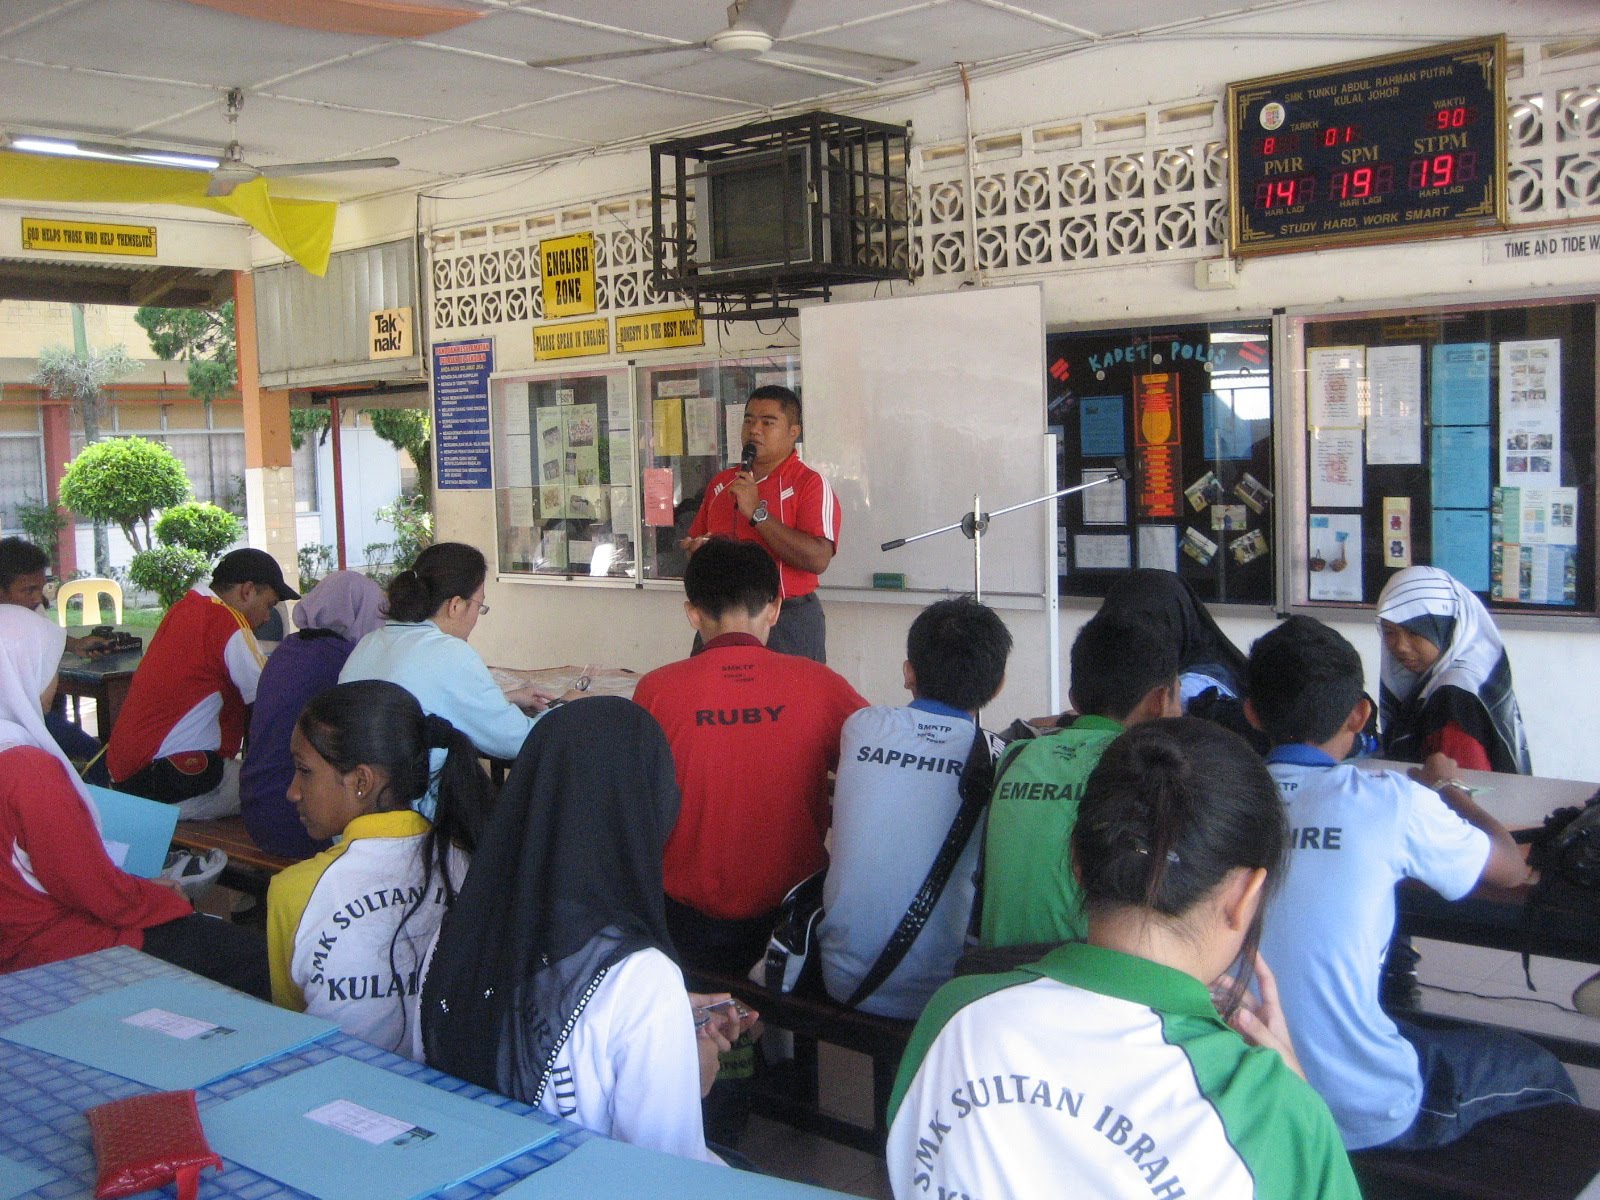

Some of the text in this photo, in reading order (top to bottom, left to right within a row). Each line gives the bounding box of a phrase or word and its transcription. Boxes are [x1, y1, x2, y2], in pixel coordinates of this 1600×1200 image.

[1308, 86, 1337, 99] TUNKU
[1341, 80, 1371, 94] ABDUL
[1376, 72, 1416, 87] RAHMAN
[1420, 65, 1453, 79] PUTRA
[1368, 87, 1399, 101] JOHOR
[1433, 97, 1465, 109] WAKTU
[1290, 120, 1319, 132] TARIKH
[1414, 131, 1468, 155] STPM
[1264, 157, 1304, 175] PMR
[1341, 145, 1379, 165] SPM
[1420, 154, 1453, 187] 19
[1265, 180, 1295, 209] 14
[1341, 168, 1372, 199] 19
[1419, 185, 1464, 198] HARI LAGI
[1265, 205, 1305, 216] HARI LAGI
[1363, 196, 1381, 205] LAGI
[1281, 222, 1317, 235] STUDY
[1363, 212, 1398, 225] WORK
[1405, 206, 1449, 220] SMART
[27, 227, 152, 248] GOD HELPS THOSE WHO HELP THEMSELVES
[1505, 234, 1600, 258] TIME AND TIDE W
[546, 246, 589, 277] ENGLISH
[556, 278, 582, 305] ZONE
[375, 314, 397, 334] Tak
[620, 319, 698, 343] HONESTY IS THE BEST POLICY
[374, 331, 402, 352] nak!
[536, 328, 606, 352] PLEASE SPEAK IN ENGLISH
[1088, 341, 1227, 373] KADET POLIS
[696, 705, 785, 726] RUBY
[918, 723, 952, 733] SMKTP
[857, 746, 964, 776] SAPPHIR
[999, 782, 1085, 801] EMERAL
[1292, 827, 1342, 850] IRE
[310, 931, 338, 985] SMK
[333, 886, 424, 930] SULTAN
[914, 1074, 1186, 1200] SMK SULTAN IBRAH
